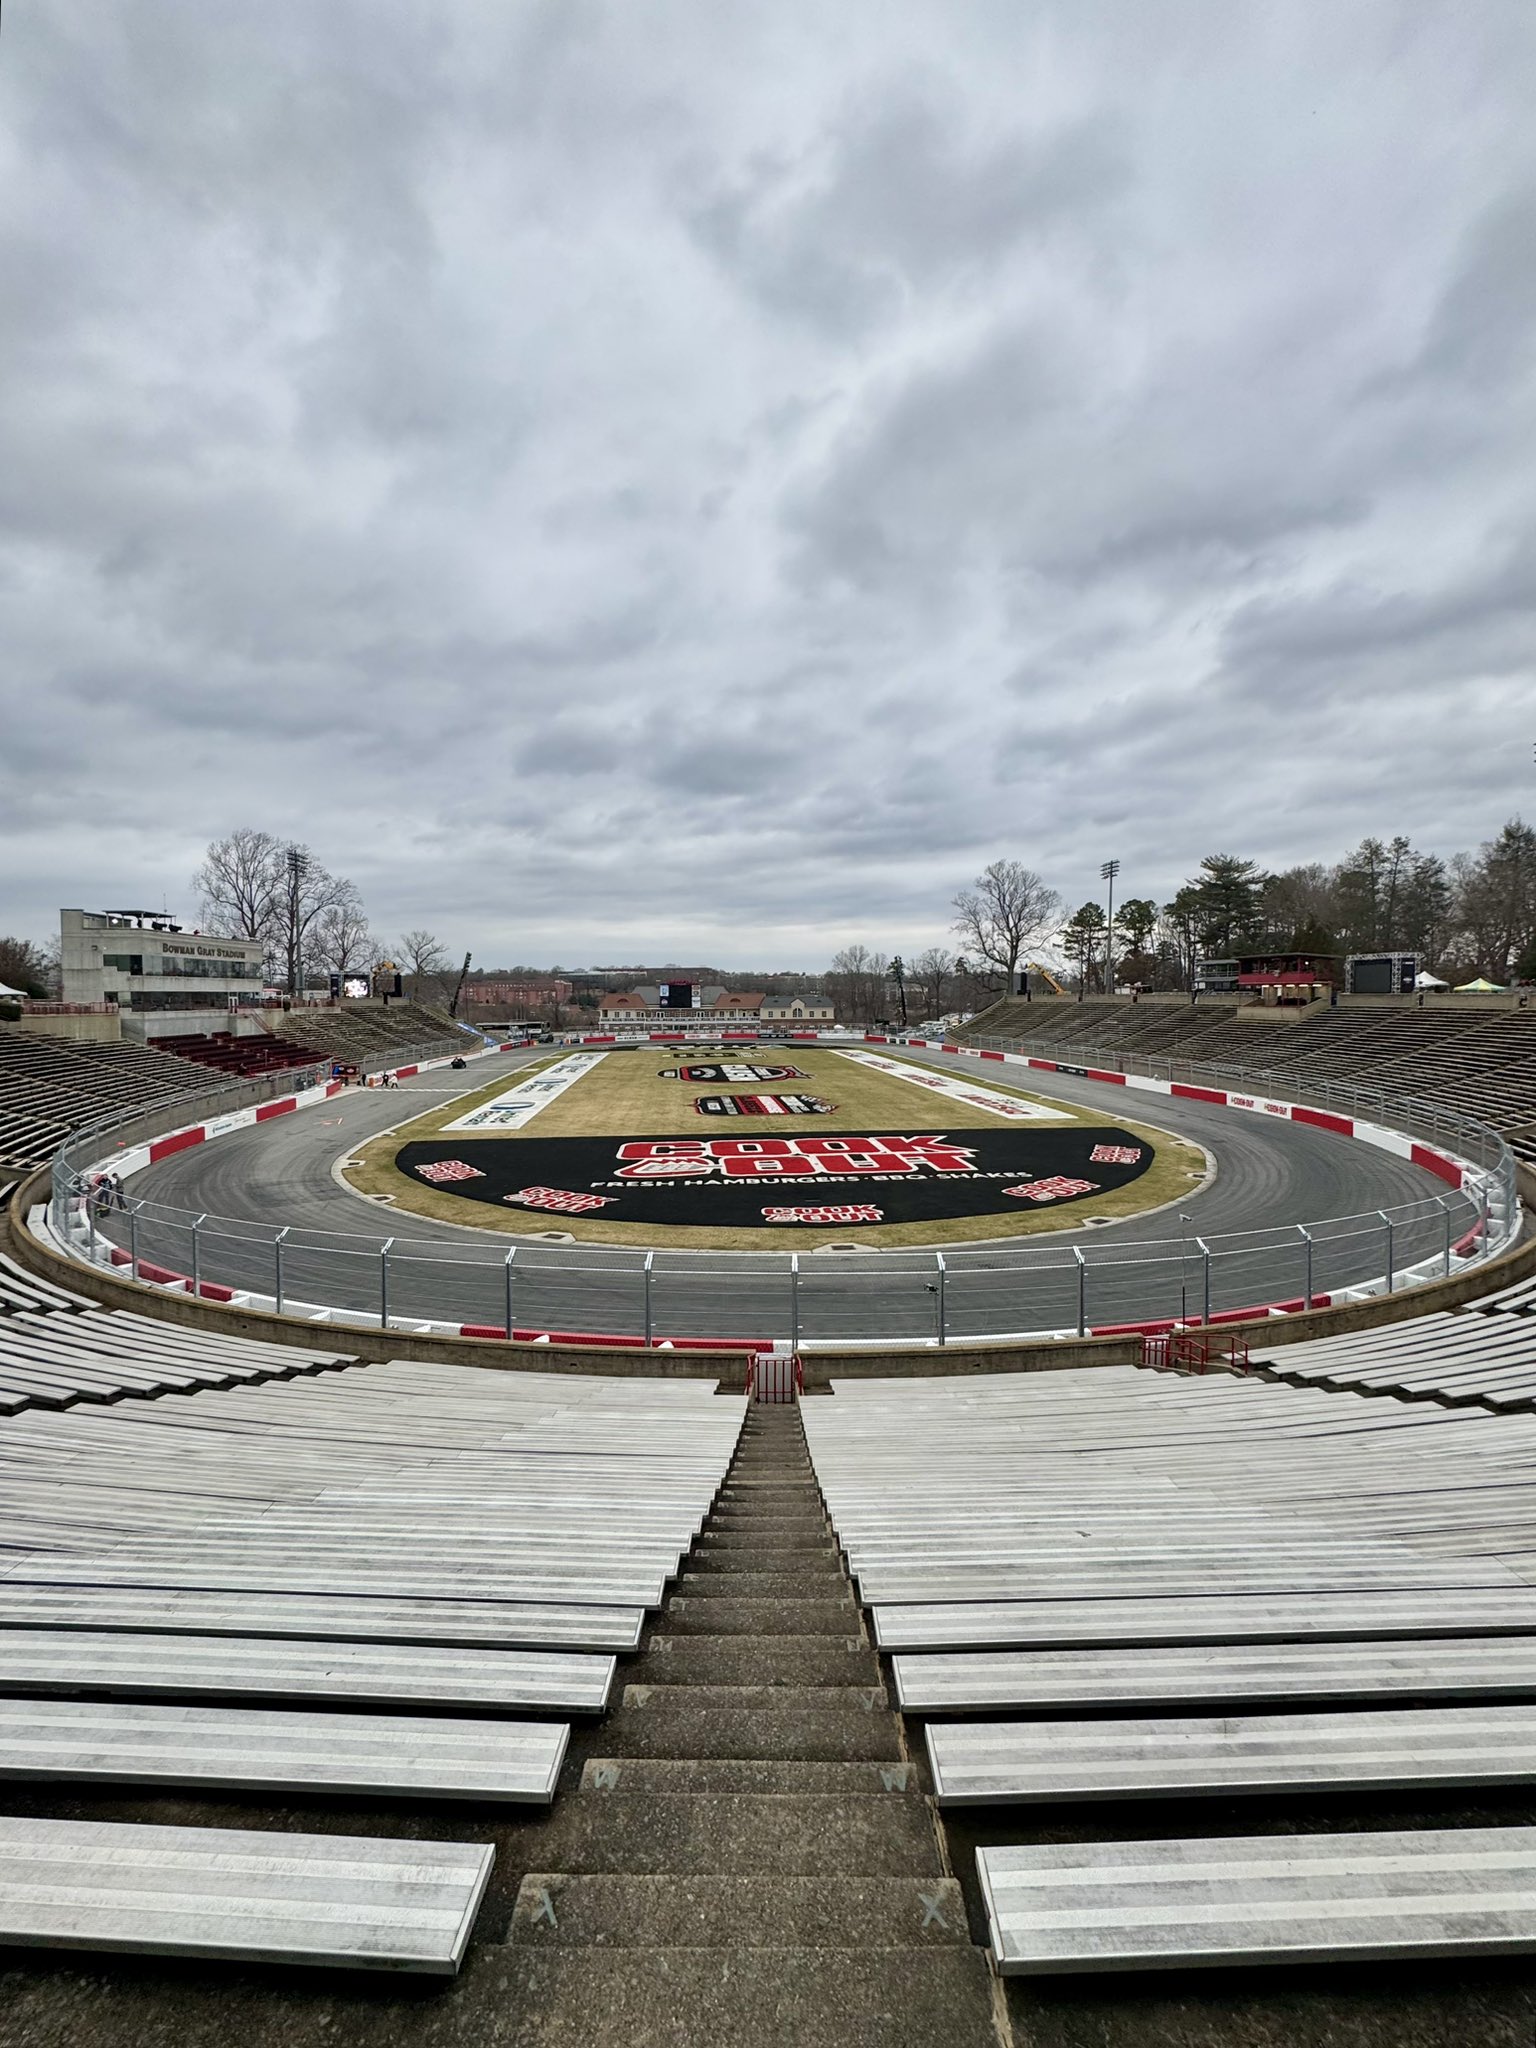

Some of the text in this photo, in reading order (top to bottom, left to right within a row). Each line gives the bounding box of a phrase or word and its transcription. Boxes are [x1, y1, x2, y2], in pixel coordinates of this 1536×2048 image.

[162, 943, 246, 959] BOWMAN GRAY STADIUM
[616, 1136, 979, 1160] COOK
[719, 1153, 978, 1176] OUT
[590, 1171, 1033, 1188] FRESH HAMBURGERS BBQ SHAKES
[518, 1186, 620, 1209] COOK
[524, 1197, 592, 1213] OUT
[761, 1204, 884, 1216] COOK
[800, 1213, 882, 1223] OUT
[593, 1766, 621, 1789] W
[879, 1768, 908, 1792] W
[917, 1892, 949, 1928] X
